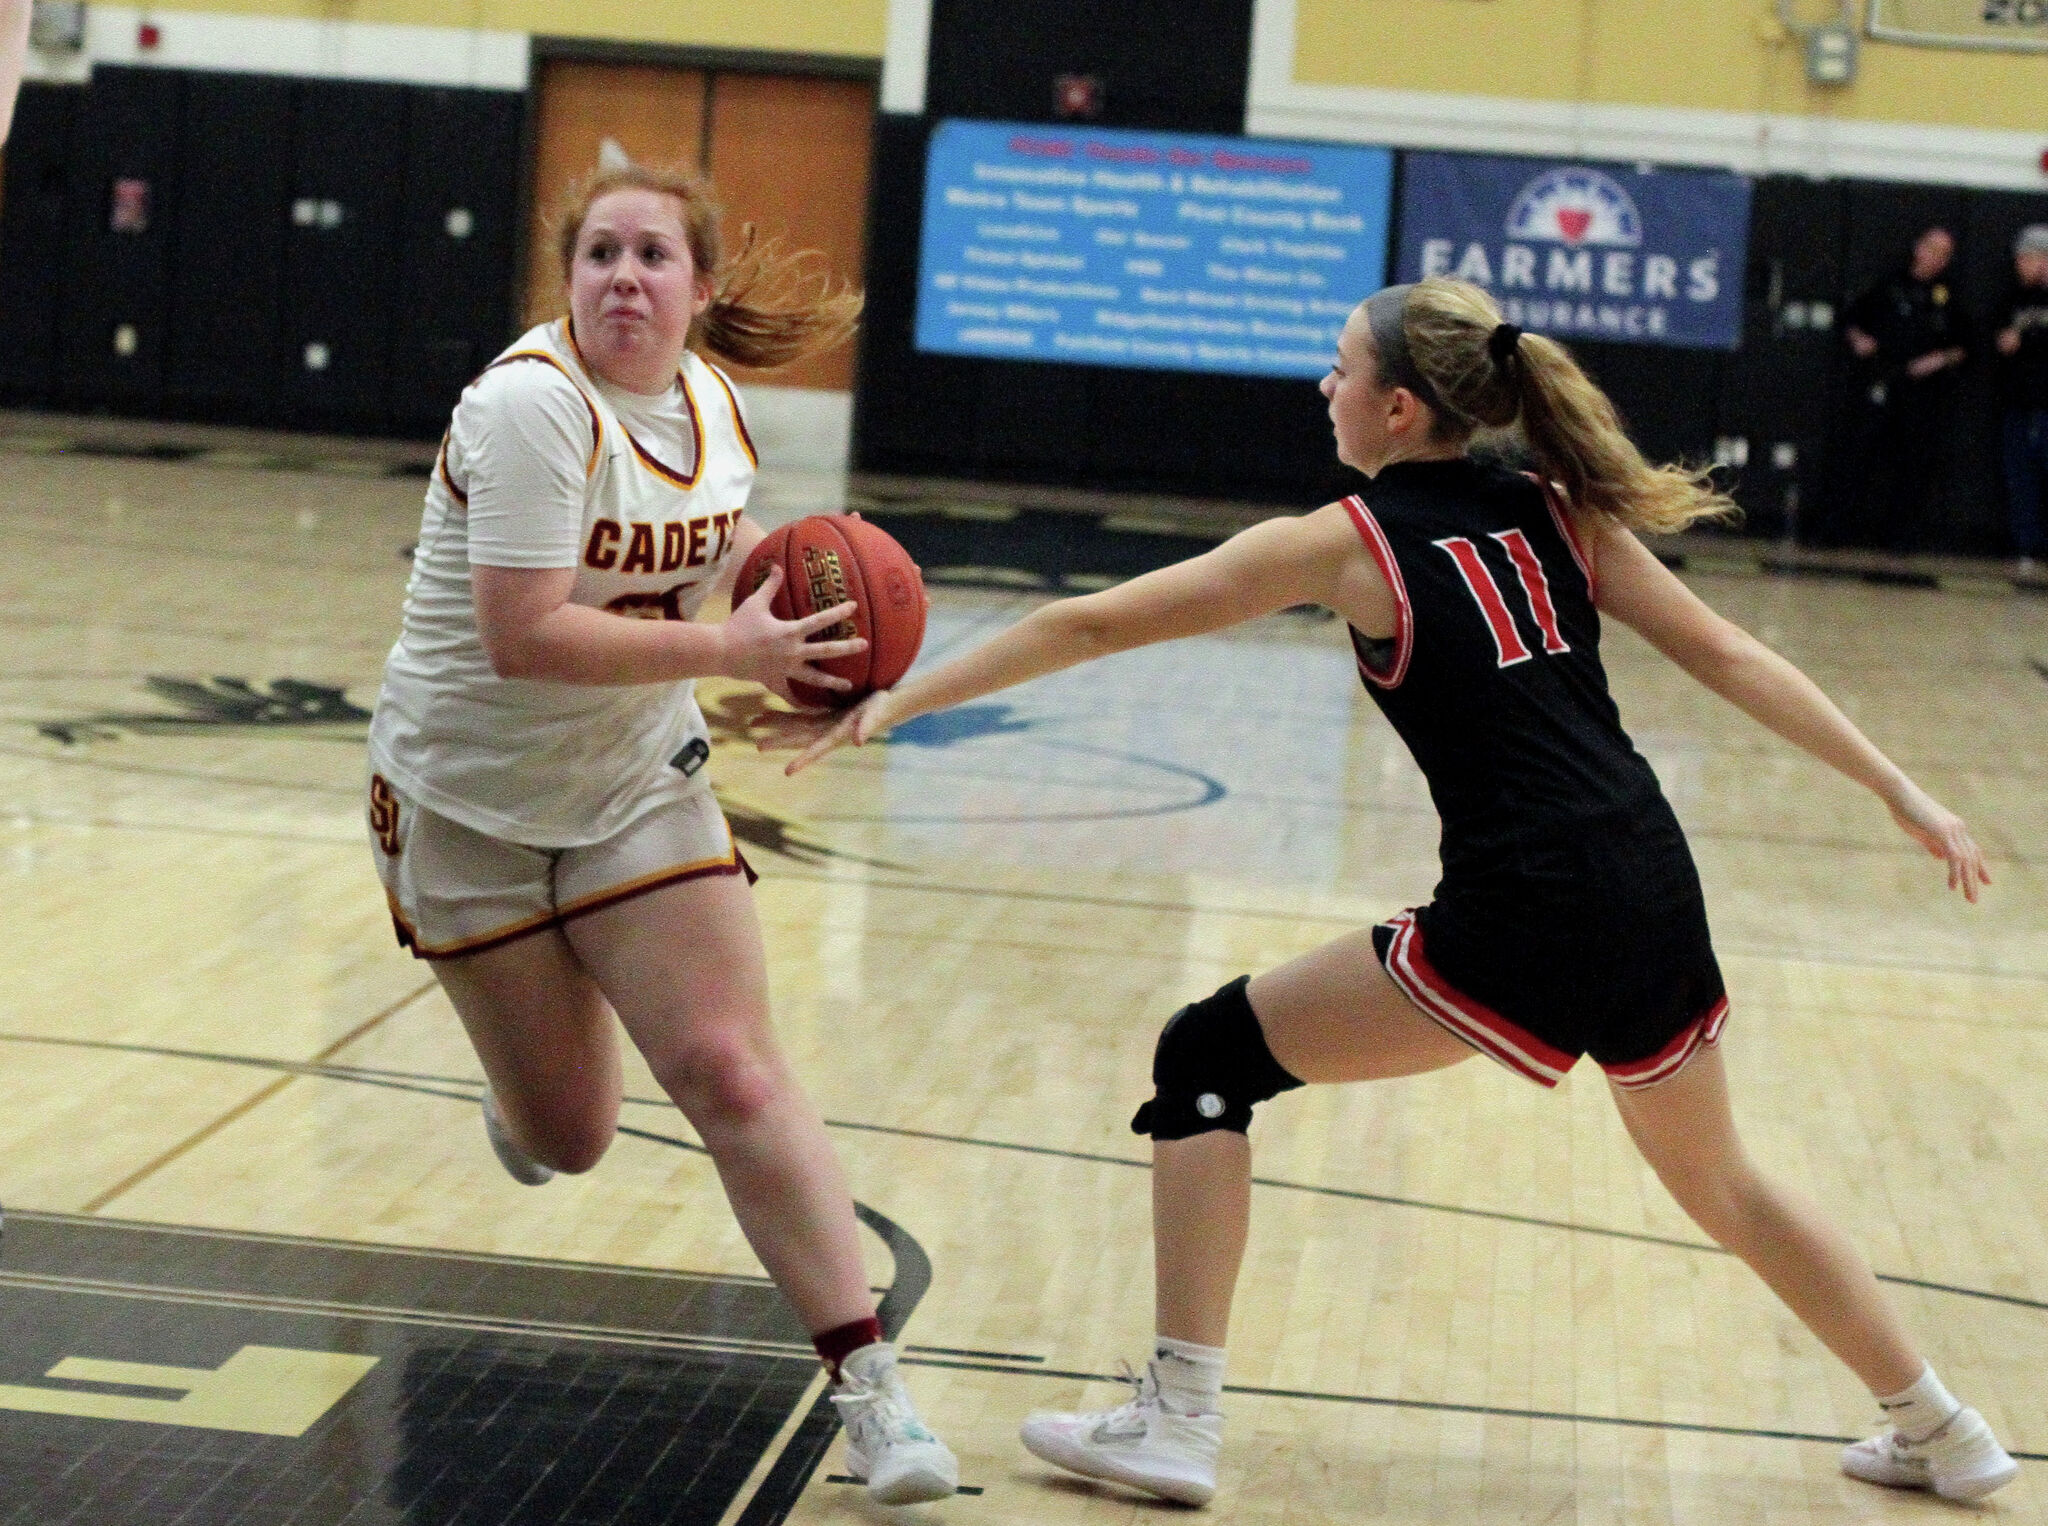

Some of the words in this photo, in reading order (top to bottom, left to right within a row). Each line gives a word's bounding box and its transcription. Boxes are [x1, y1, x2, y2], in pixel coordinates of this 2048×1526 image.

[1421, 238, 1720, 302] FARMERS
[1500, 295, 1668, 336] SURANCE
[1431, 528, 1571, 668] 11
